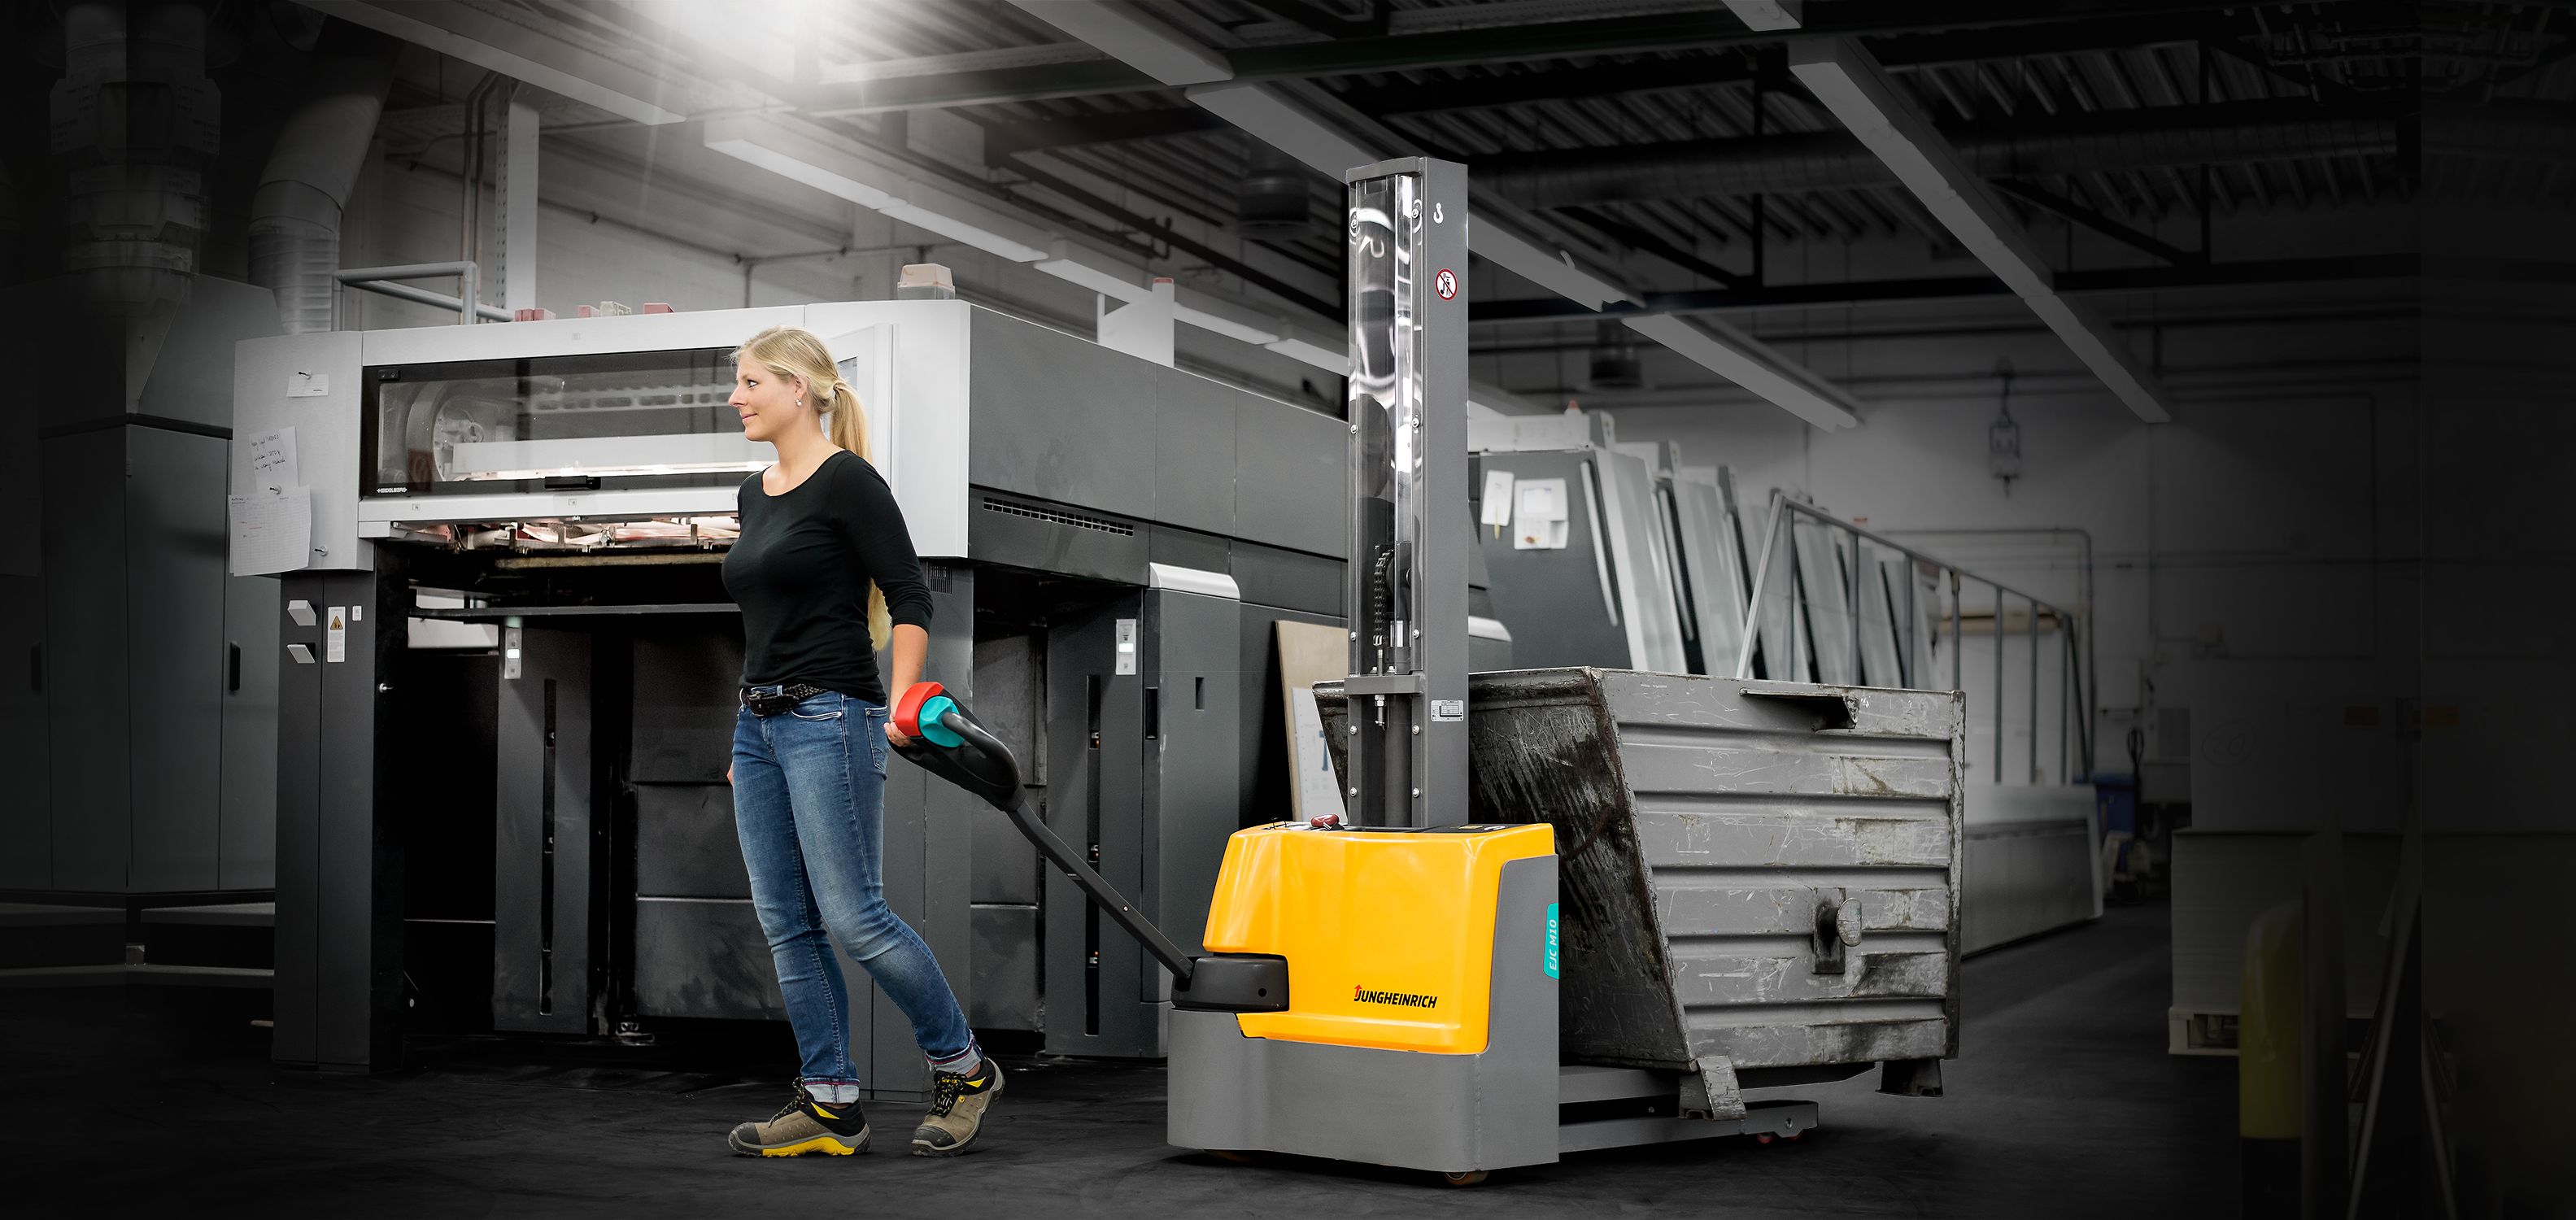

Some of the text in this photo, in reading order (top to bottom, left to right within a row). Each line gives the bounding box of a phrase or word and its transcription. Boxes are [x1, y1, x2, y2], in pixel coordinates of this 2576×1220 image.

[1549, 919, 1557, 970] EJC M10
[1353, 986, 1437, 1009] JUNGHEINRICH
